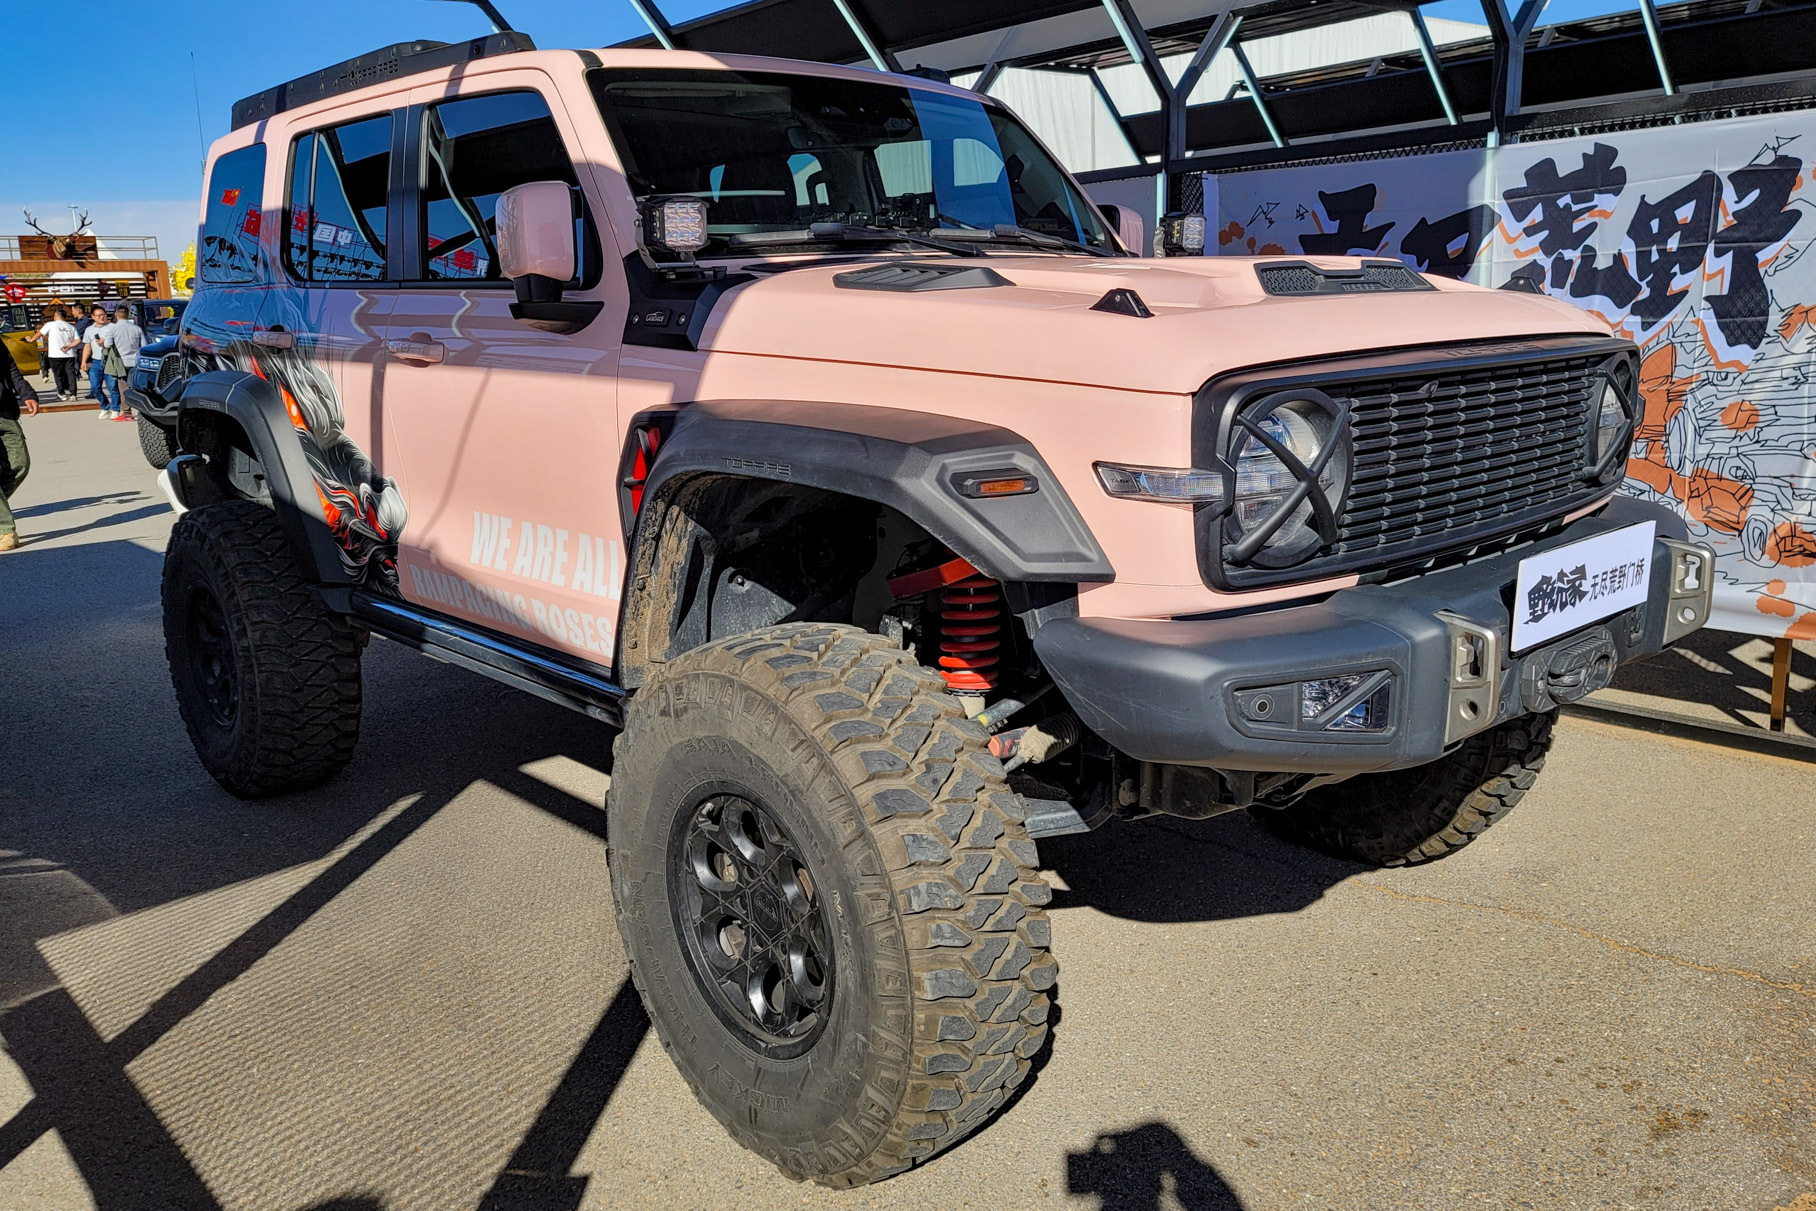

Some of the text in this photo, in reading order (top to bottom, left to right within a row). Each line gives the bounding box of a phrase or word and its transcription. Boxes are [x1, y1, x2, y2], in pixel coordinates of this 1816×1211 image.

[470, 511, 621, 600] WE ARE ALL
[1589, 557, 1645, 602] 无尽荒野门桥
[409, 564, 613, 658] RAMPAGING ROSES
